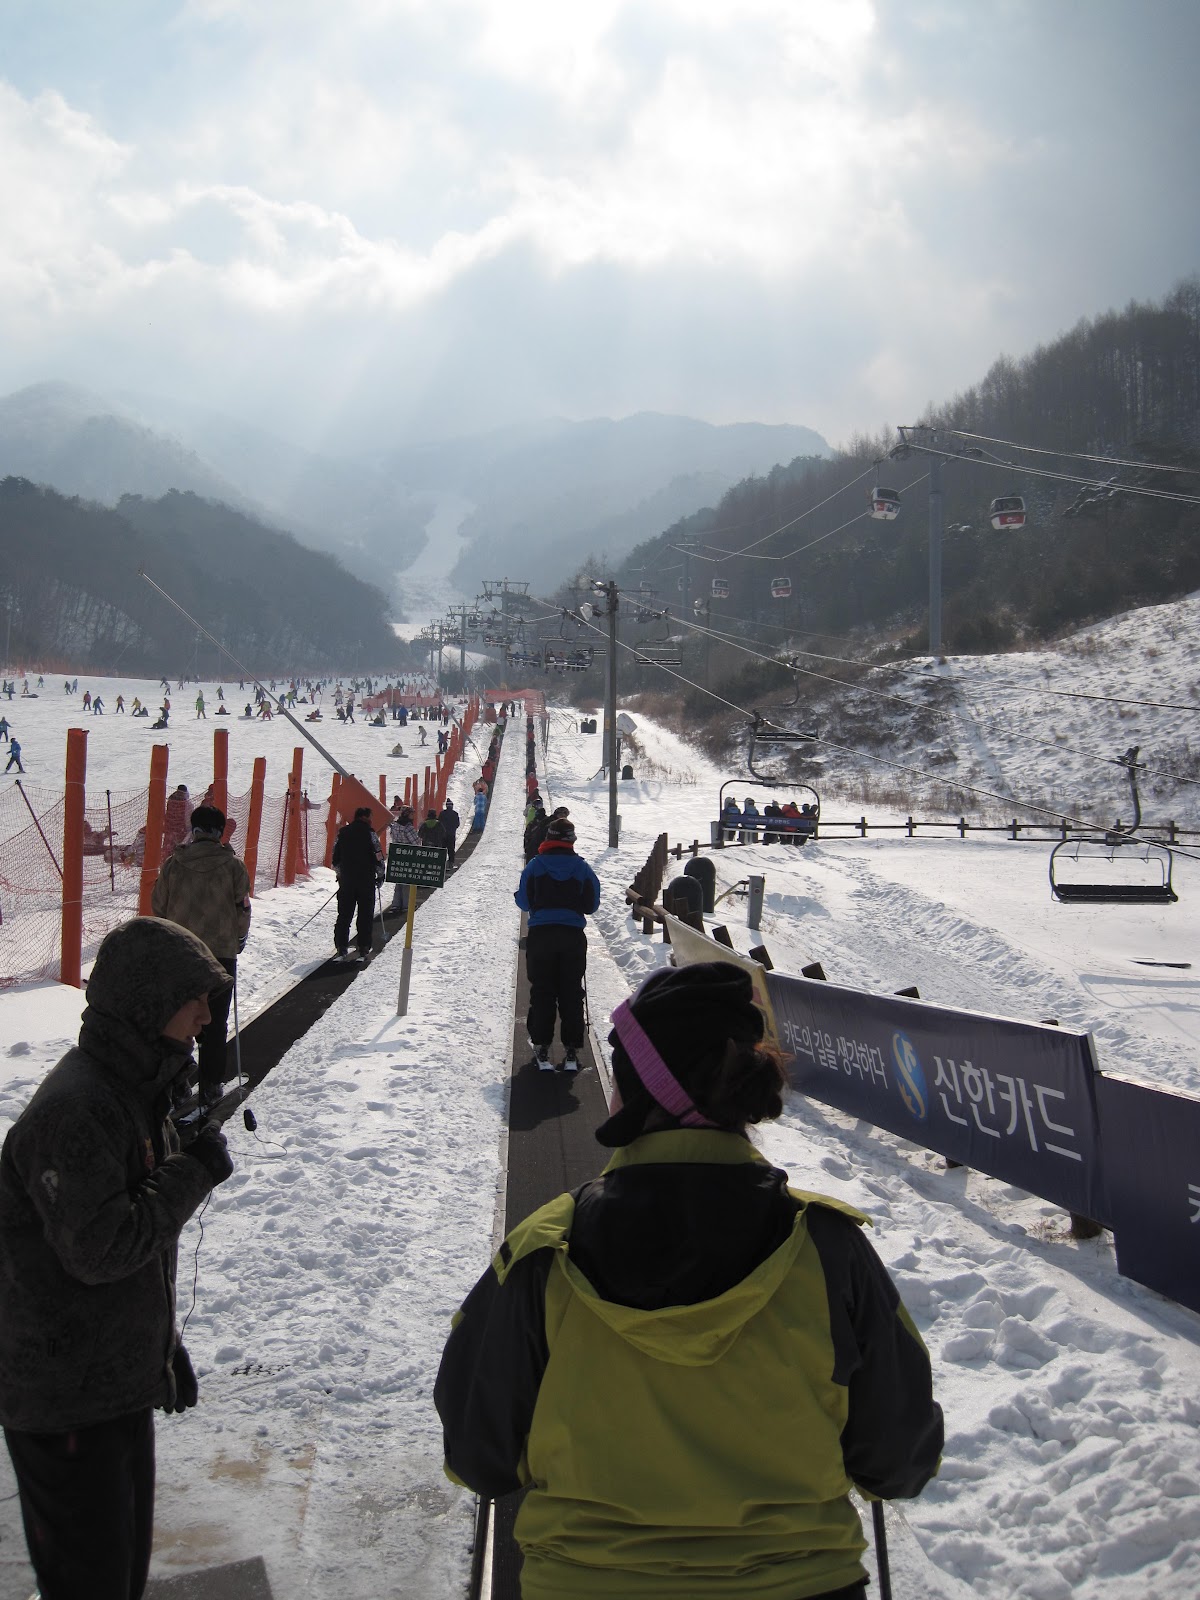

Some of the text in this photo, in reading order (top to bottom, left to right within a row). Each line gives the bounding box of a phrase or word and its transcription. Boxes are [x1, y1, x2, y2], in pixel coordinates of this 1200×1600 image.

[416, 850, 439, 858] 유의사항
[783, 1020, 816, 1063] 카드의
[812, 1029, 838, 1071] 길을
[835, 1035, 889, 1090] 생각하다
[934, 1055, 1082, 1161] 신한카드
